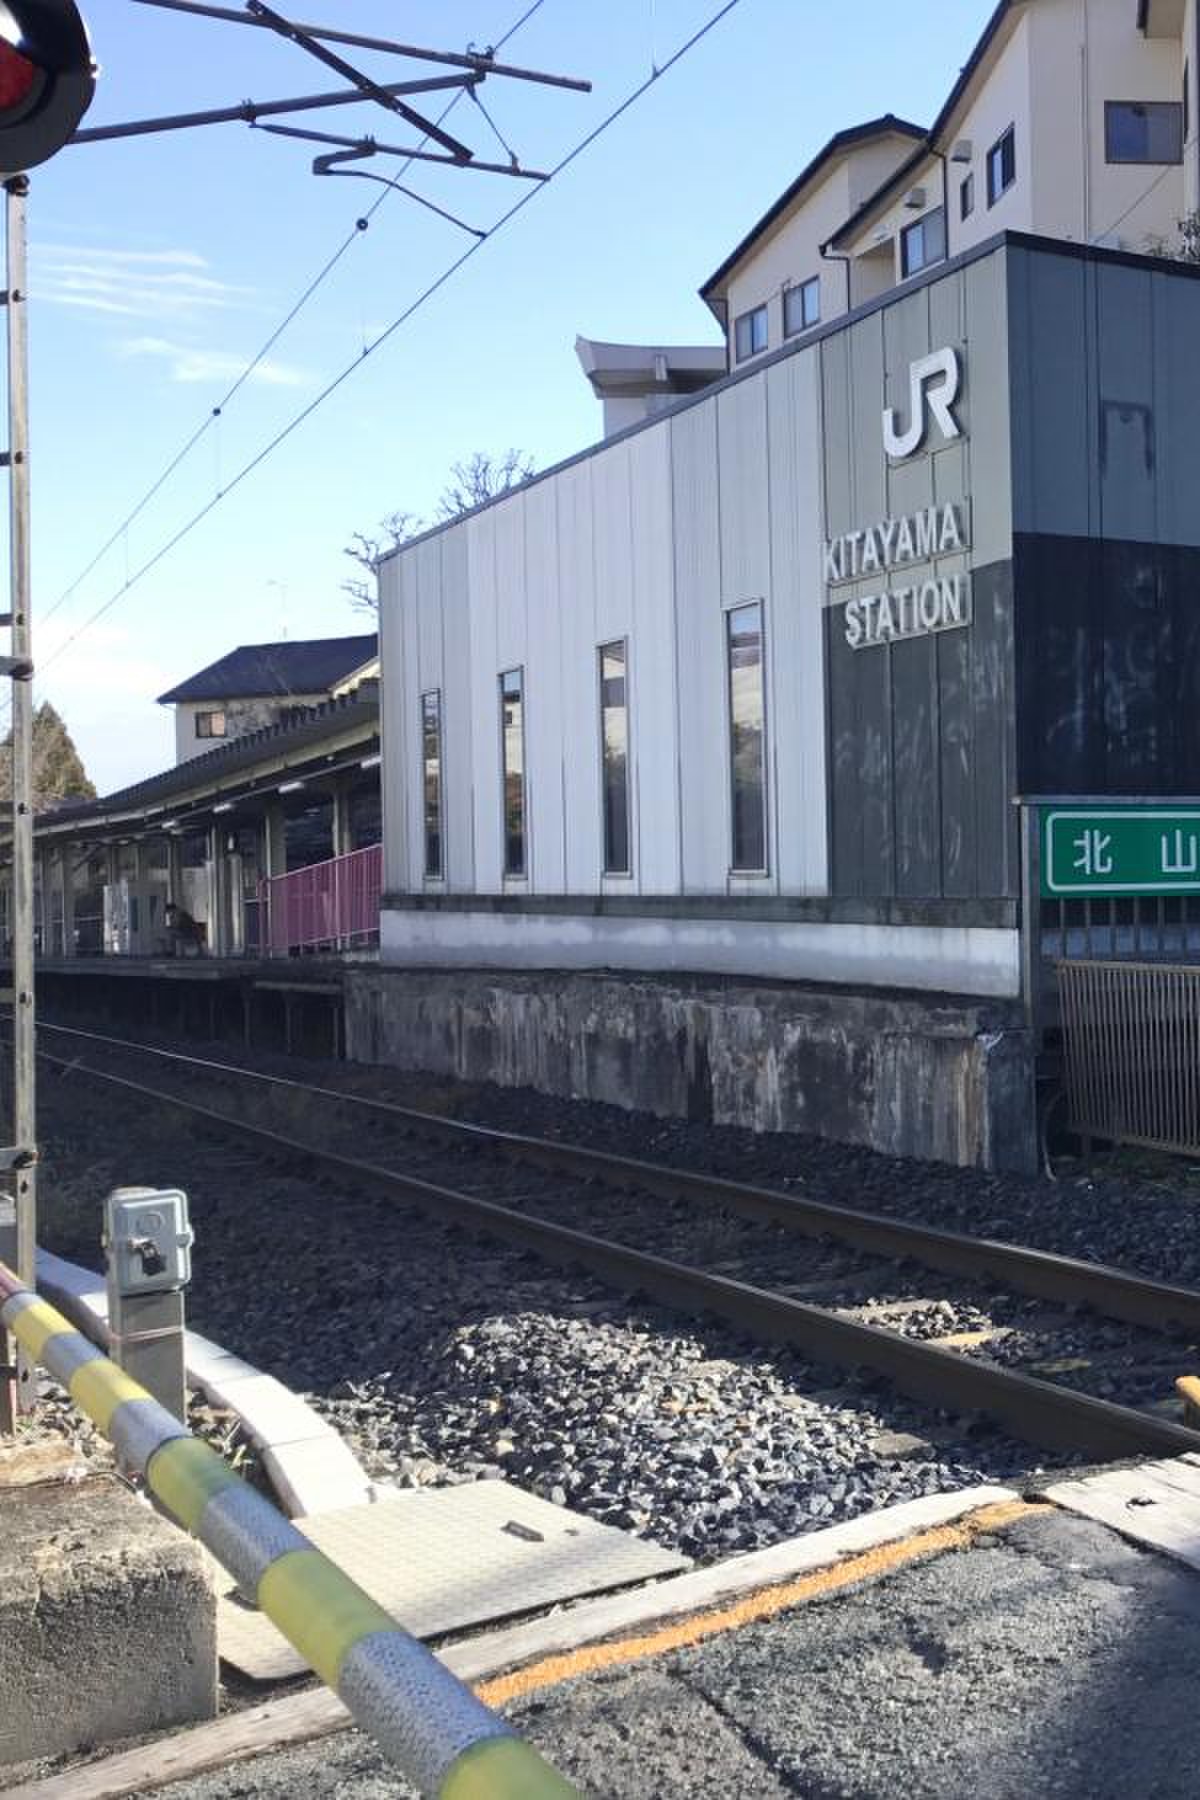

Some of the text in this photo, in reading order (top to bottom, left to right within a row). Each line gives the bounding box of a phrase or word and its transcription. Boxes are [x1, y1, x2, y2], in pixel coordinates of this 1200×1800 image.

[883, 347, 960, 457] JR
[824, 502, 962, 582] KITAYAMA
[845, 574, 962, 647] STATION
[1073, 829, 1198, 875] 北山
